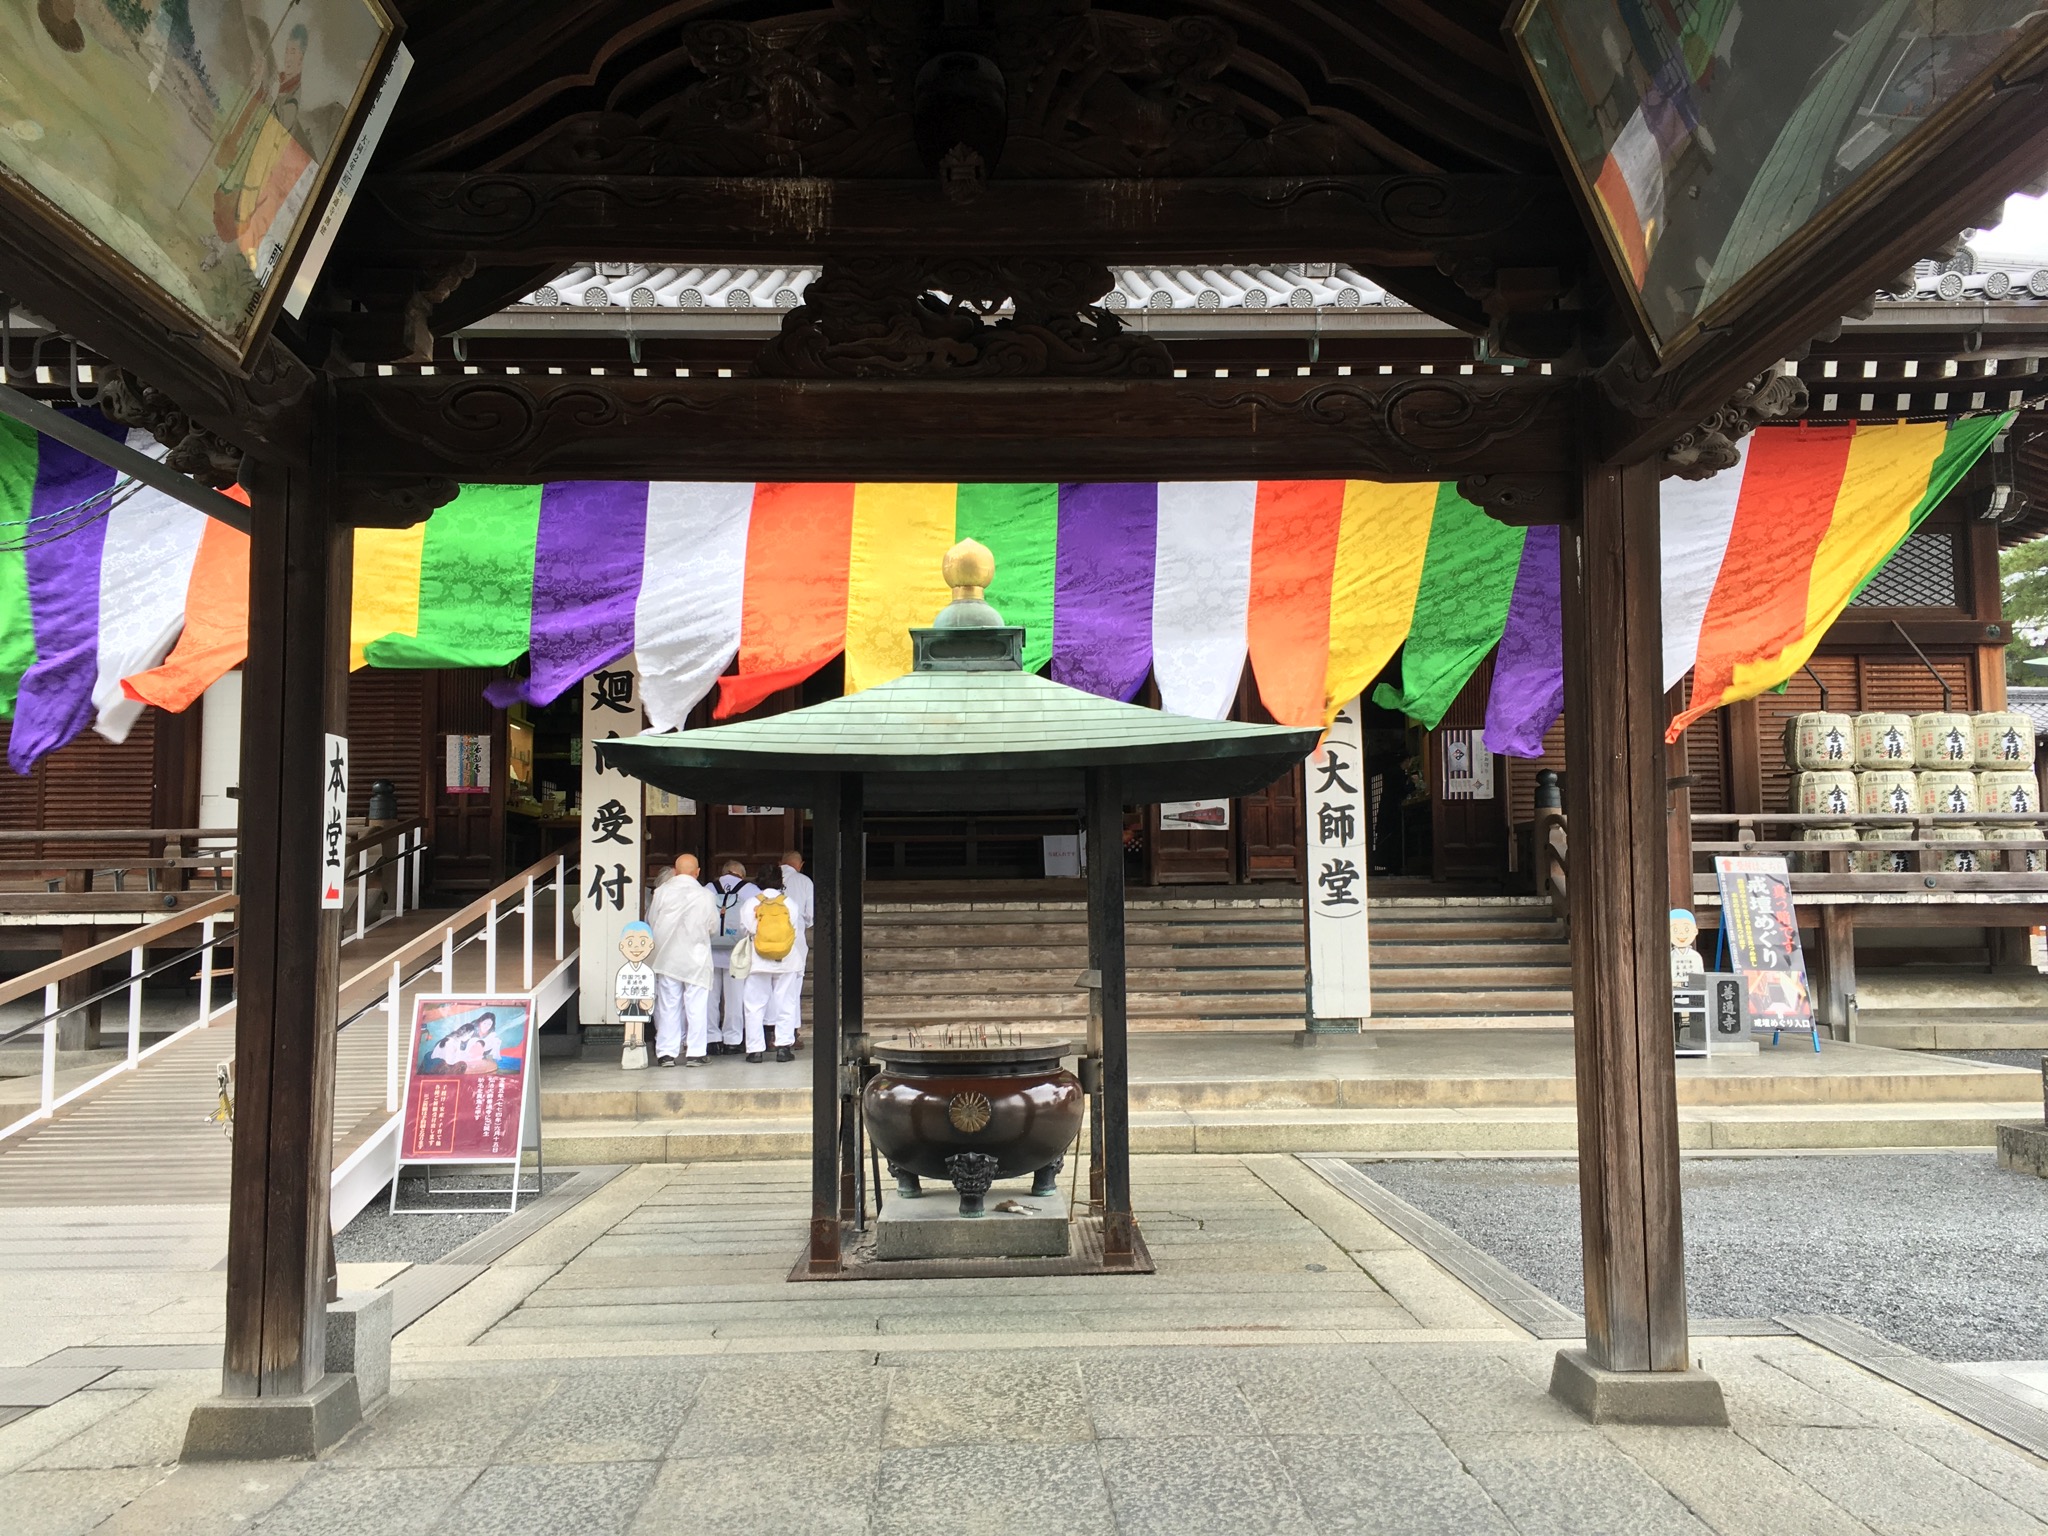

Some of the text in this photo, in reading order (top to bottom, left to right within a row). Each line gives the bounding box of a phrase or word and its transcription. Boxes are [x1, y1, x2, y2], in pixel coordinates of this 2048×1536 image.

[326, 741, 346, 867] 本堂
[1746, 875, 1777, 968] 戒壇めぐり
[621, 985, 650, 997] 大師堂
[1721, 983, 1737, 1031] 善通寺
[1753, 1018, 1811, 1028] 戒壇めぐり入口
